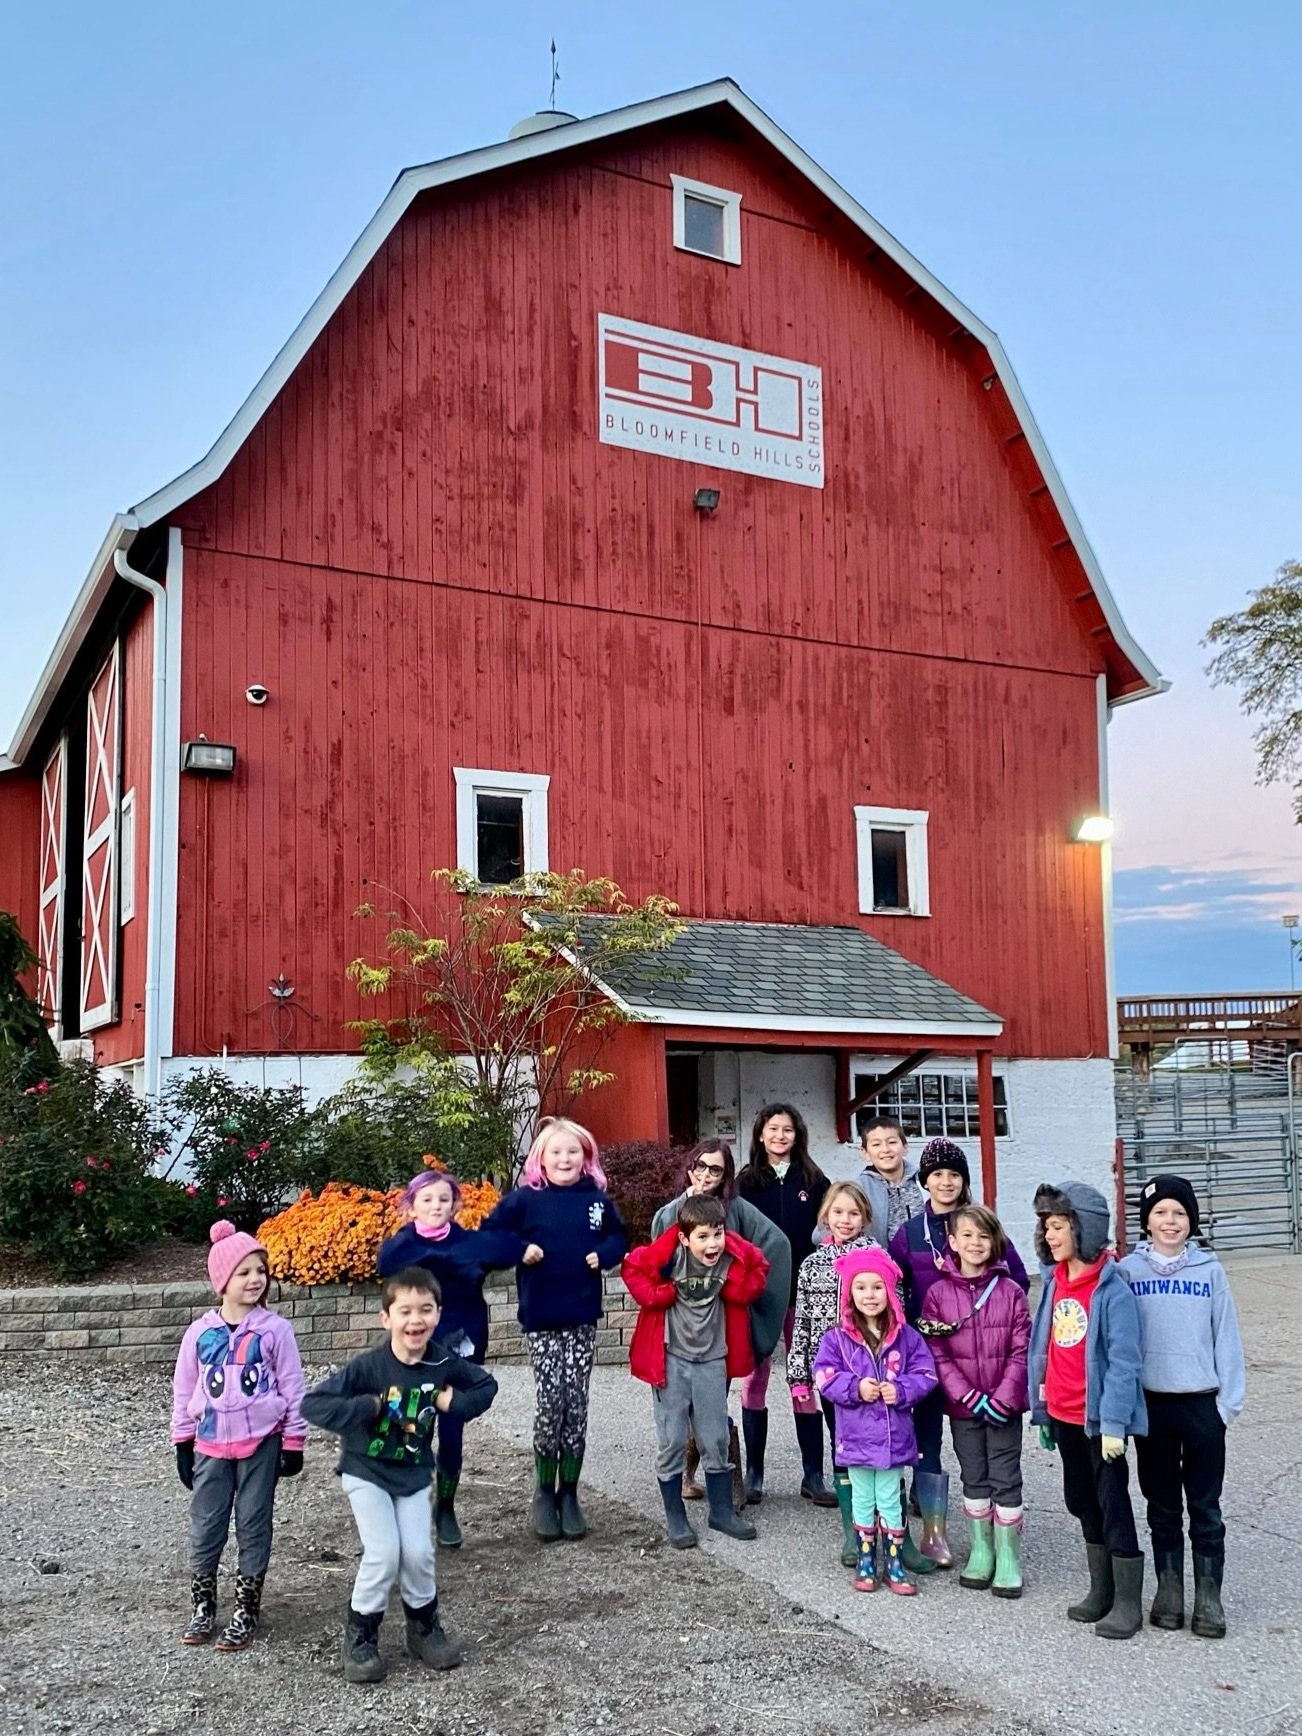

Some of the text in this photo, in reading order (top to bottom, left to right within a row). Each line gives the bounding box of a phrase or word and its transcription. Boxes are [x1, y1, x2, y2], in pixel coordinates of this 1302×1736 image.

[606, 414, 803, 469] BLOOMFIELD HILLS
[808, 379, 821, 473] SCHOOLS
